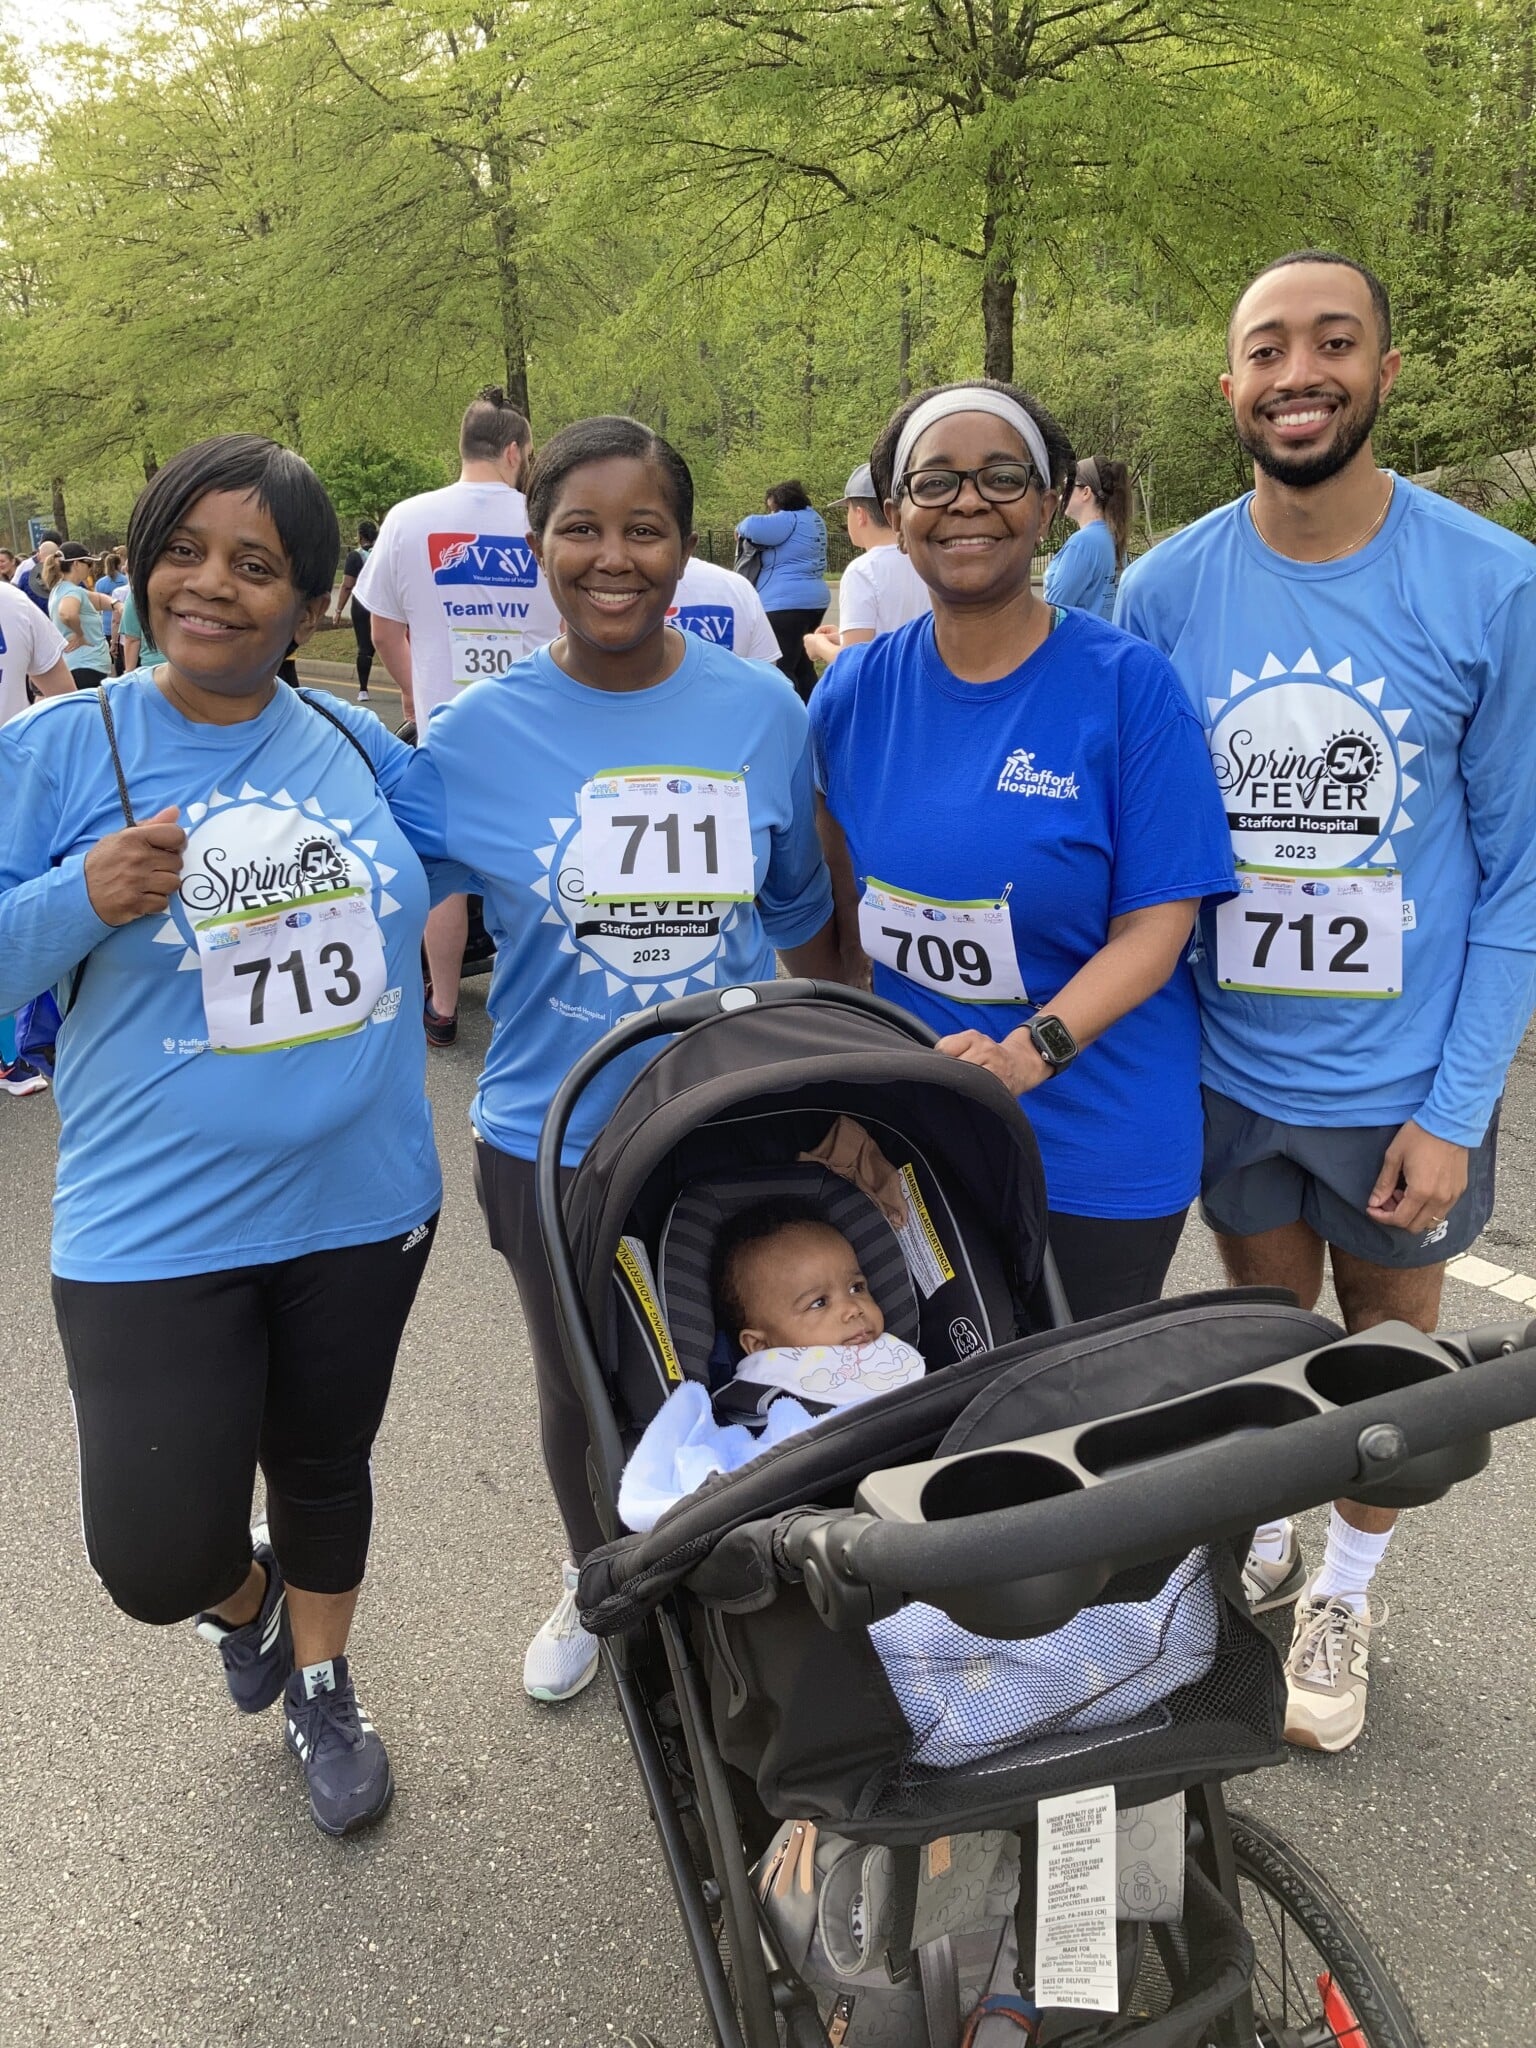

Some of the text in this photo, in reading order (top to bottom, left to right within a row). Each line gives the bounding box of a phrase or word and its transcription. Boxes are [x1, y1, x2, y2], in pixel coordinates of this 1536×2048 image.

[443, 602, 530, 618] Team VIV
[465, 648, 512, 674] 330
[1211, 729, 1330, 801] Spring
[1014, 767, 1075, 786] Stafford
[997, 778, 1080, 800] Hospital 5K
[1251, 782, 1367, 811] FEVER
[1238, 816, 1358, 833] Stafford Hospital
[612, 814, 718, 874] 711
[1275, 844, 1317, 859] 2023
[180, 848, 305, 916] Spring
[600, 923, 709, 937] Stafford Hospital
[1245, 911, 1369, 973] 712
[632, 949, 670, 963] 2023
[881, 926, 992, 986] 709
[234, 942, 361, 1025] 713
[907, 1171, 923, 1208] WARNING
[923, 1217, 951, 1274] ADVERTENCIA
[650, 1312, 673, 1361] WARNING
[1047, 1815, 1064, 1824] UNDER
[1065, 1809, 1086, 1819] PENALTY
[1051, 1824, 1075, 1834] REMOVED
[1077, 1820, 1095, 1828] EXCEPT
[1062, 1827, 1091, 1837] CONSUMER
[1076, 1837, 1101, 1846] MATERIAL
[1048, 1858, 1061, 1866] SEAT
[1089, 1857, 1103, 1865] FIBER
[1063, 1873, 1078, 1881] FOAM
[1042, 1977, 1056, 1985] DATE
[1065, 1977, 1091, 1985] DELIVERY
[1081, 1997, 1100, 2005] CHINA
